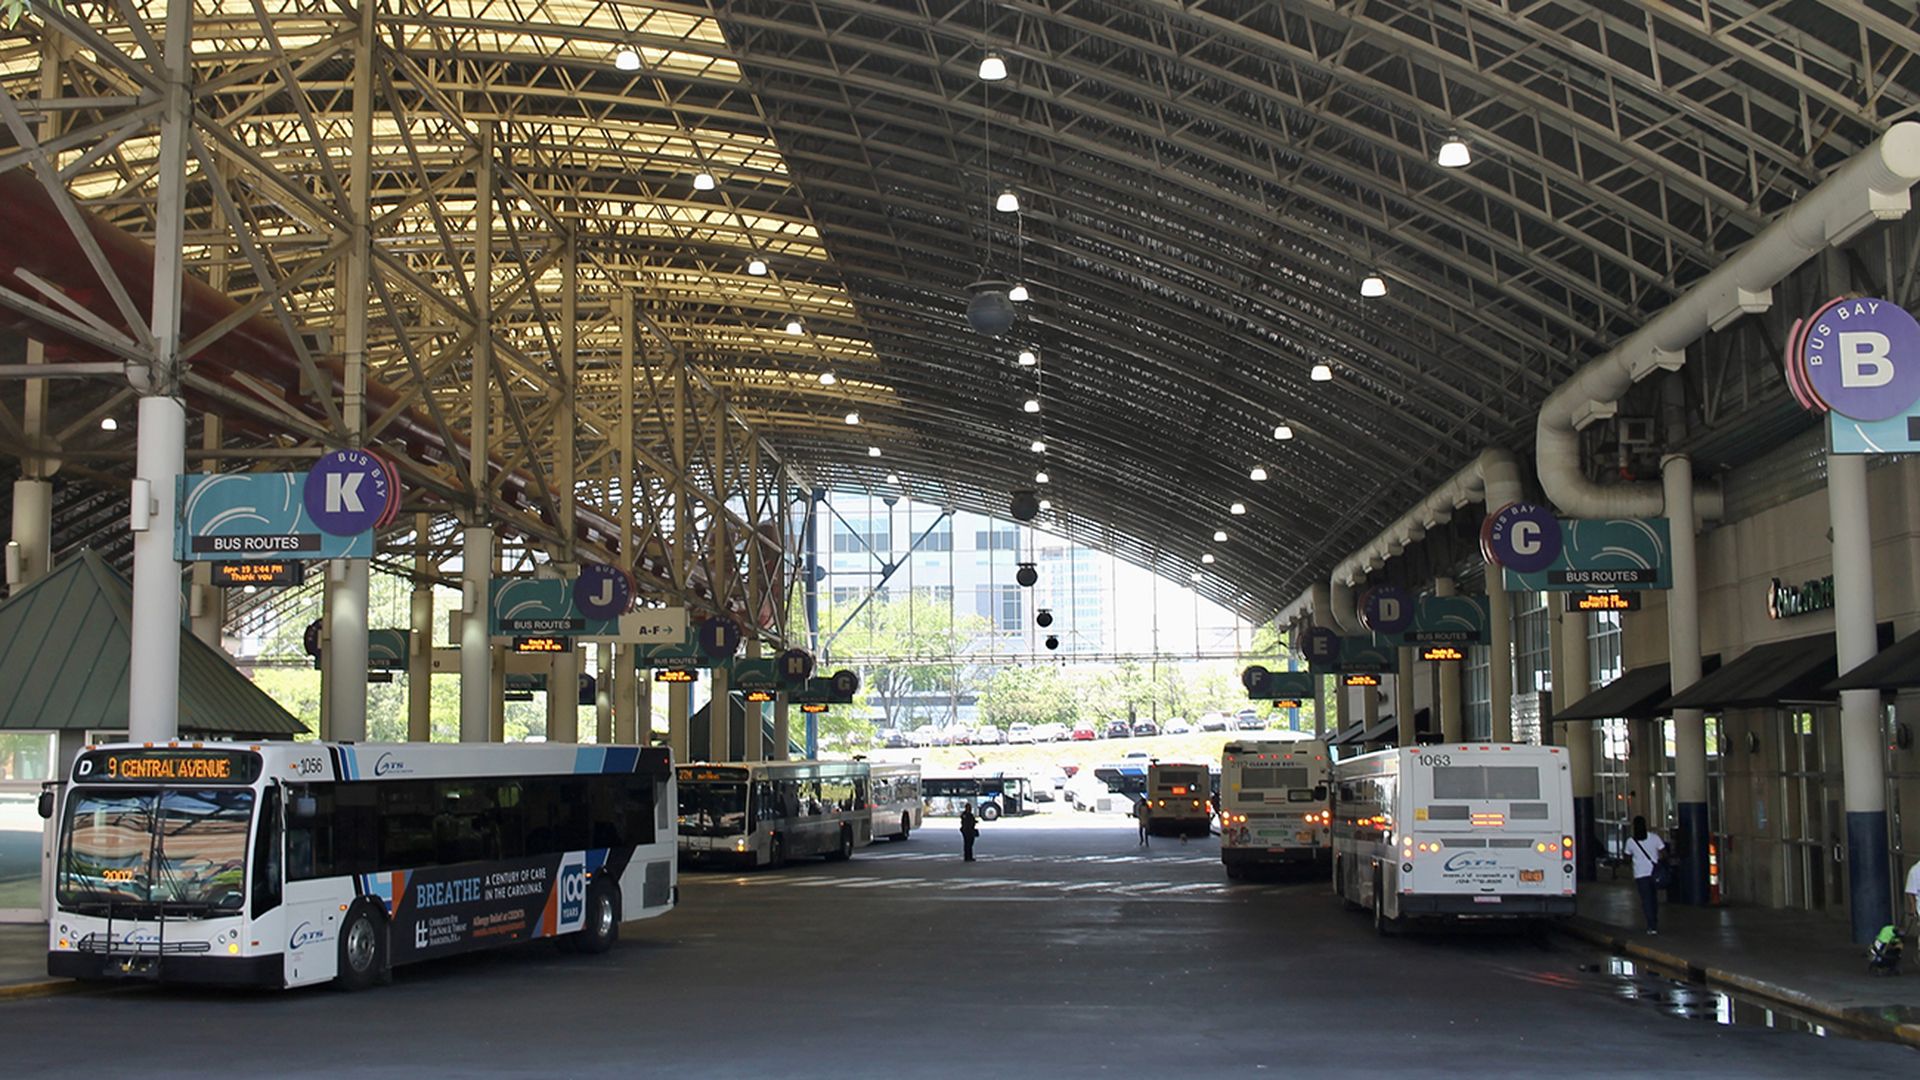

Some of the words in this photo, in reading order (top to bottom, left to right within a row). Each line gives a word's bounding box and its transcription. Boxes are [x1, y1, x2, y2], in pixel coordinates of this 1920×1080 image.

[1810, 323, 1831, 366] BUS
[1837, 302, 1879, 320] BAY
[1838, 331, 1895, 388] B
[337, 451, 369, 467] BUS
[370, 467, 386, 498] BAY
[325, 472, 366, 513] K
[1493, 515, 1508, 541] BUS
[1511, 505, 1536, 516] BAY
[214, 537, 242, 550] BUS
[244, 536, 300, 550] ROUTES
[1511, 520, 1542, 555] C
[1566, 571, 1590, 582] BUS
[1592, 570, 1638, 582] ROUTES
[588, 578, 613, 606] J
[1379, 598, 1400, 621] D
[514, 621, 533, 630] BUS
[535, 620, 571, 630] ROUTES
[639, 626, 661, 636] A-F
[1313, 636, 1328, 655] E
[1437, 632, 1468, 641] ROUTES
[654, 657, 669, 665] BUS
[670, 656, 698, 665] ROUTES
[788, 658, 804, 675] H
[839, 678, 851, 692] G
[1252, 673, 1262, 686] F
[78, 760, 93, 776] D
[108, 757, 117, 778] 9
[121, 759, 176, 778] CENTRAL
[178, 759, 230, 777] AVENUE
[300, 757, 323, 773] 1056
[1419, 754, 1451, 766] 1063
[485, 875, 491, 886] A
[491, 870, 519, 885] CENTURY
[521, 868, 530, 881] OF
[530, 867, 547, 880] CARE
[416, 877, 481, 909] BREATHE
[485, 889, 493, 900] IN
[494, 886, 506, 899] THE
[562, 872, 585, 904] 100
